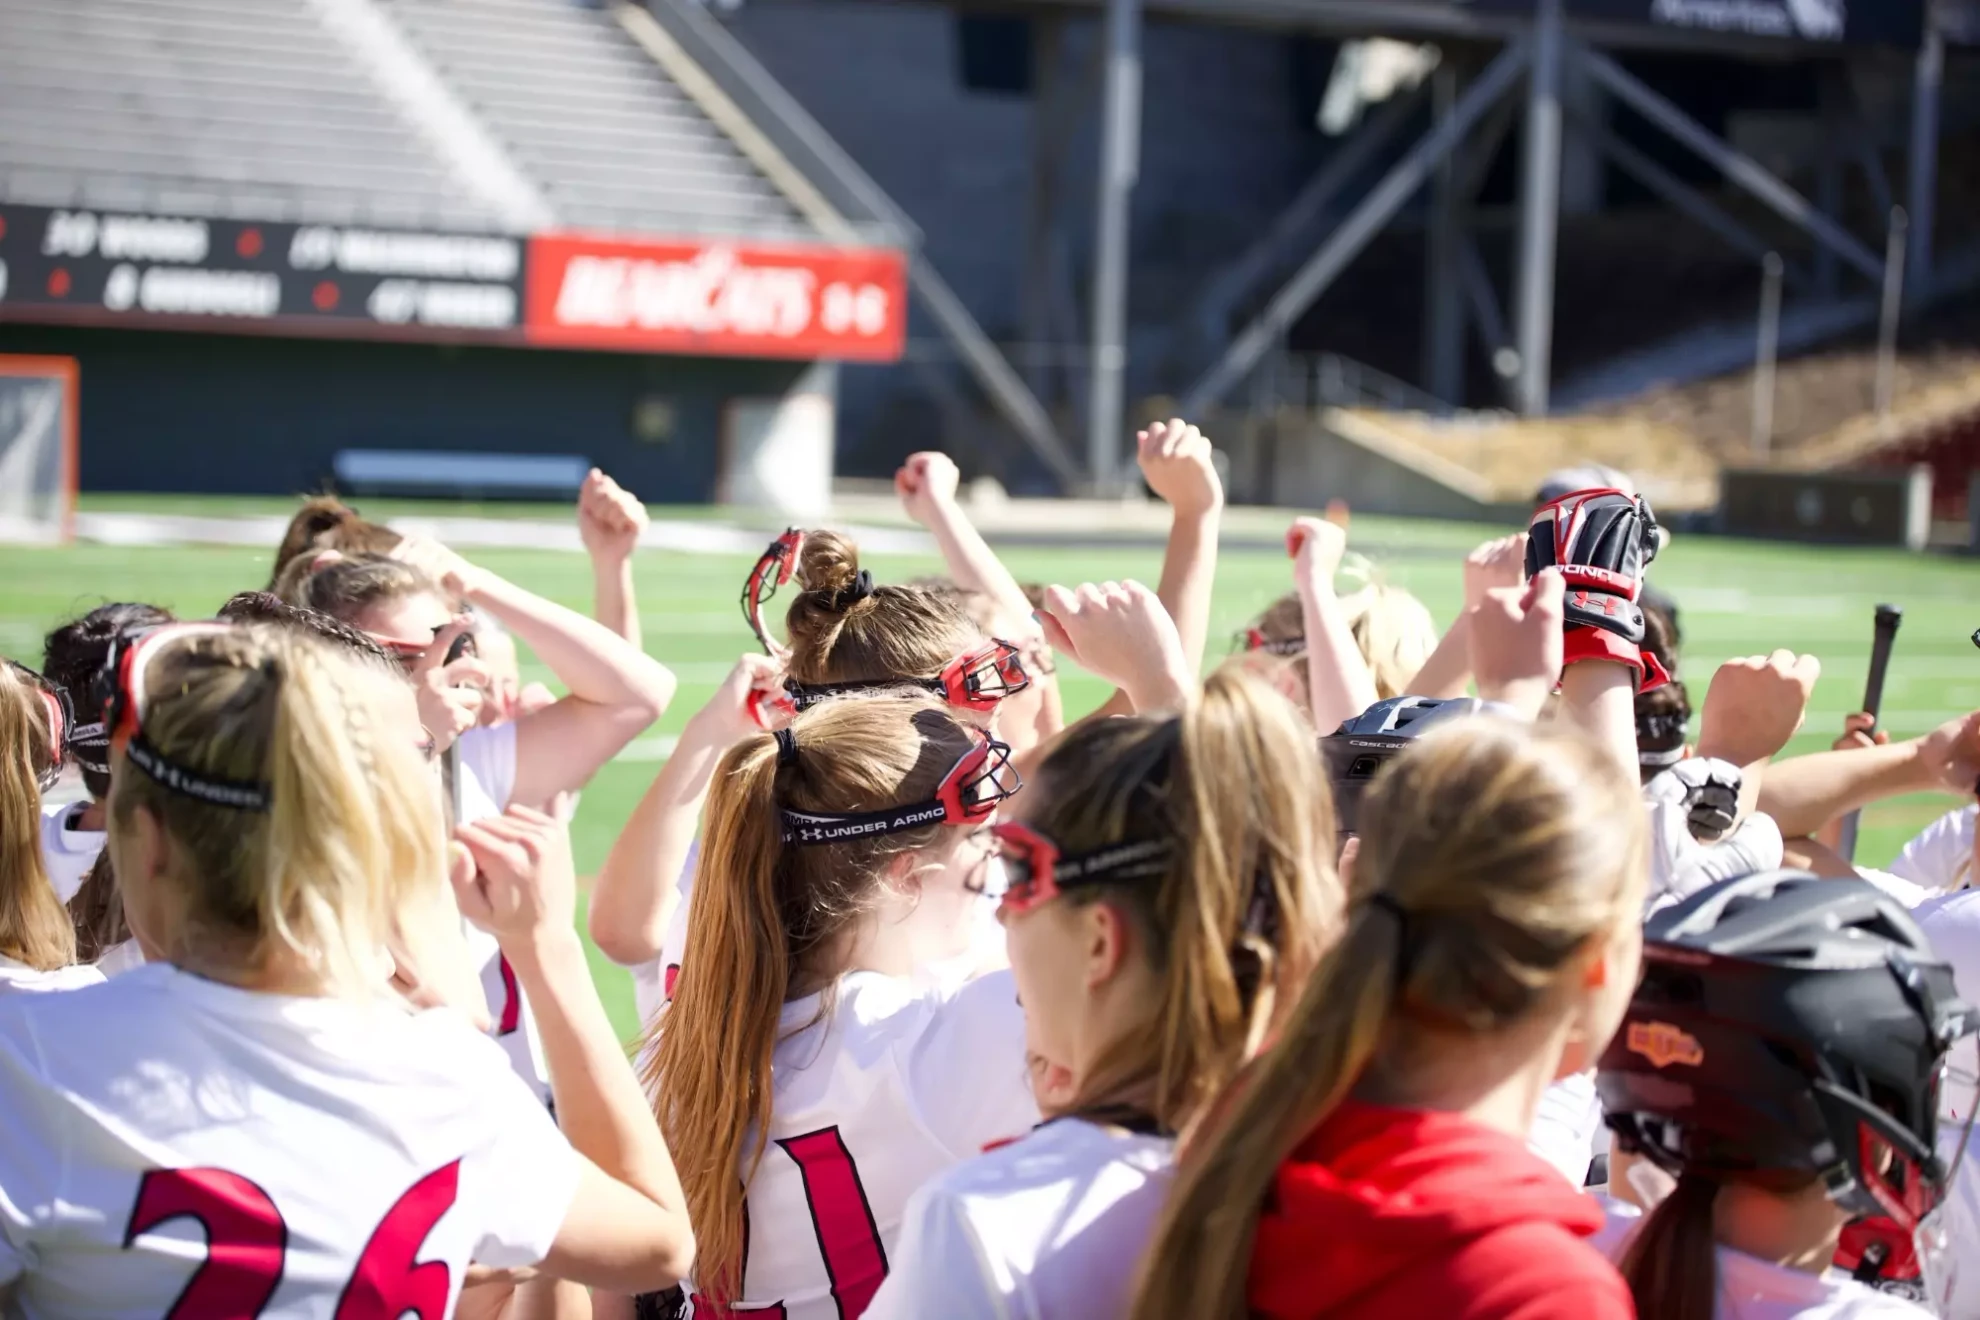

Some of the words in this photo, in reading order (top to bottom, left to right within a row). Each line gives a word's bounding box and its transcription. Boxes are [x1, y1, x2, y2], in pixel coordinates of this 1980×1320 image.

[825, 821, 888, 838] UNDER
[893, 807, 945, 827] ARMO
[122, 1157, 462, 1320] 26
